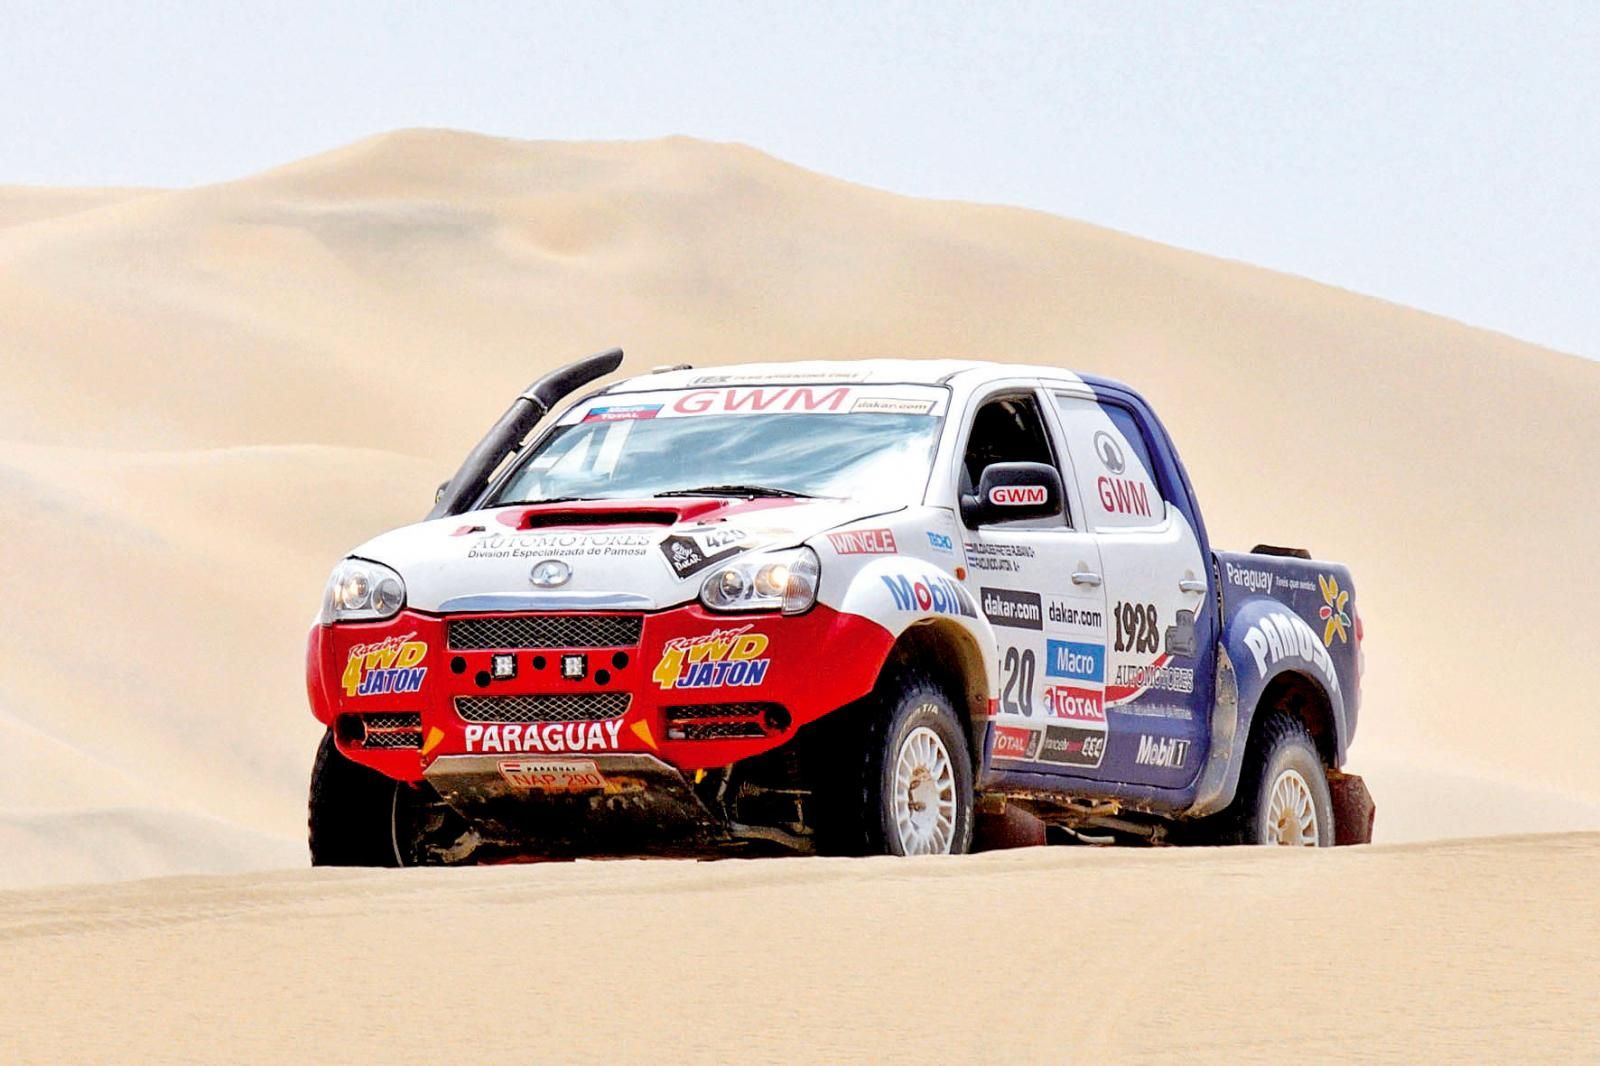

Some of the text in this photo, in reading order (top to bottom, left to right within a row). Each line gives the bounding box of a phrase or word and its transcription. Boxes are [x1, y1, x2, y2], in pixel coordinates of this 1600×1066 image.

[673, 388, 851, 413] GWM
[993, 488, 1044, 503] GWM
[1098, 476, 1152, 517] GWM
[512, 547, 585, 559] Especializada
[587, 546, 601, 556] de
[604, 546, 647, 556] Pamosa
[829, 530, 896, 553] WINGLE
[674, 553, 702, 571] DAKAR
[1226, 562, 1273, 594] Paraguay
[880, 574, 959, 615] Mobil
[984, 593, 1040, 621] dakar.com
[1049, 600, 1102, 628] dakar.com
[1114, 600, 1160, 654] 1928
[675, 658, 771, 689] JATON
[1057, 647, 1094, 675] Macro
[357, 667, 428, 696] JATON
[997, 643, 1036, 717] 20
[1115, 665, 1194, 693] AUTOMOTORES
[1057, 690, 1104, 718] TOTAL
[465, 719, 624, 752] PARAGUAY
[992, 730, 1026, 751] TOTAL
[1135, 734, 1174, 768] Mobil
